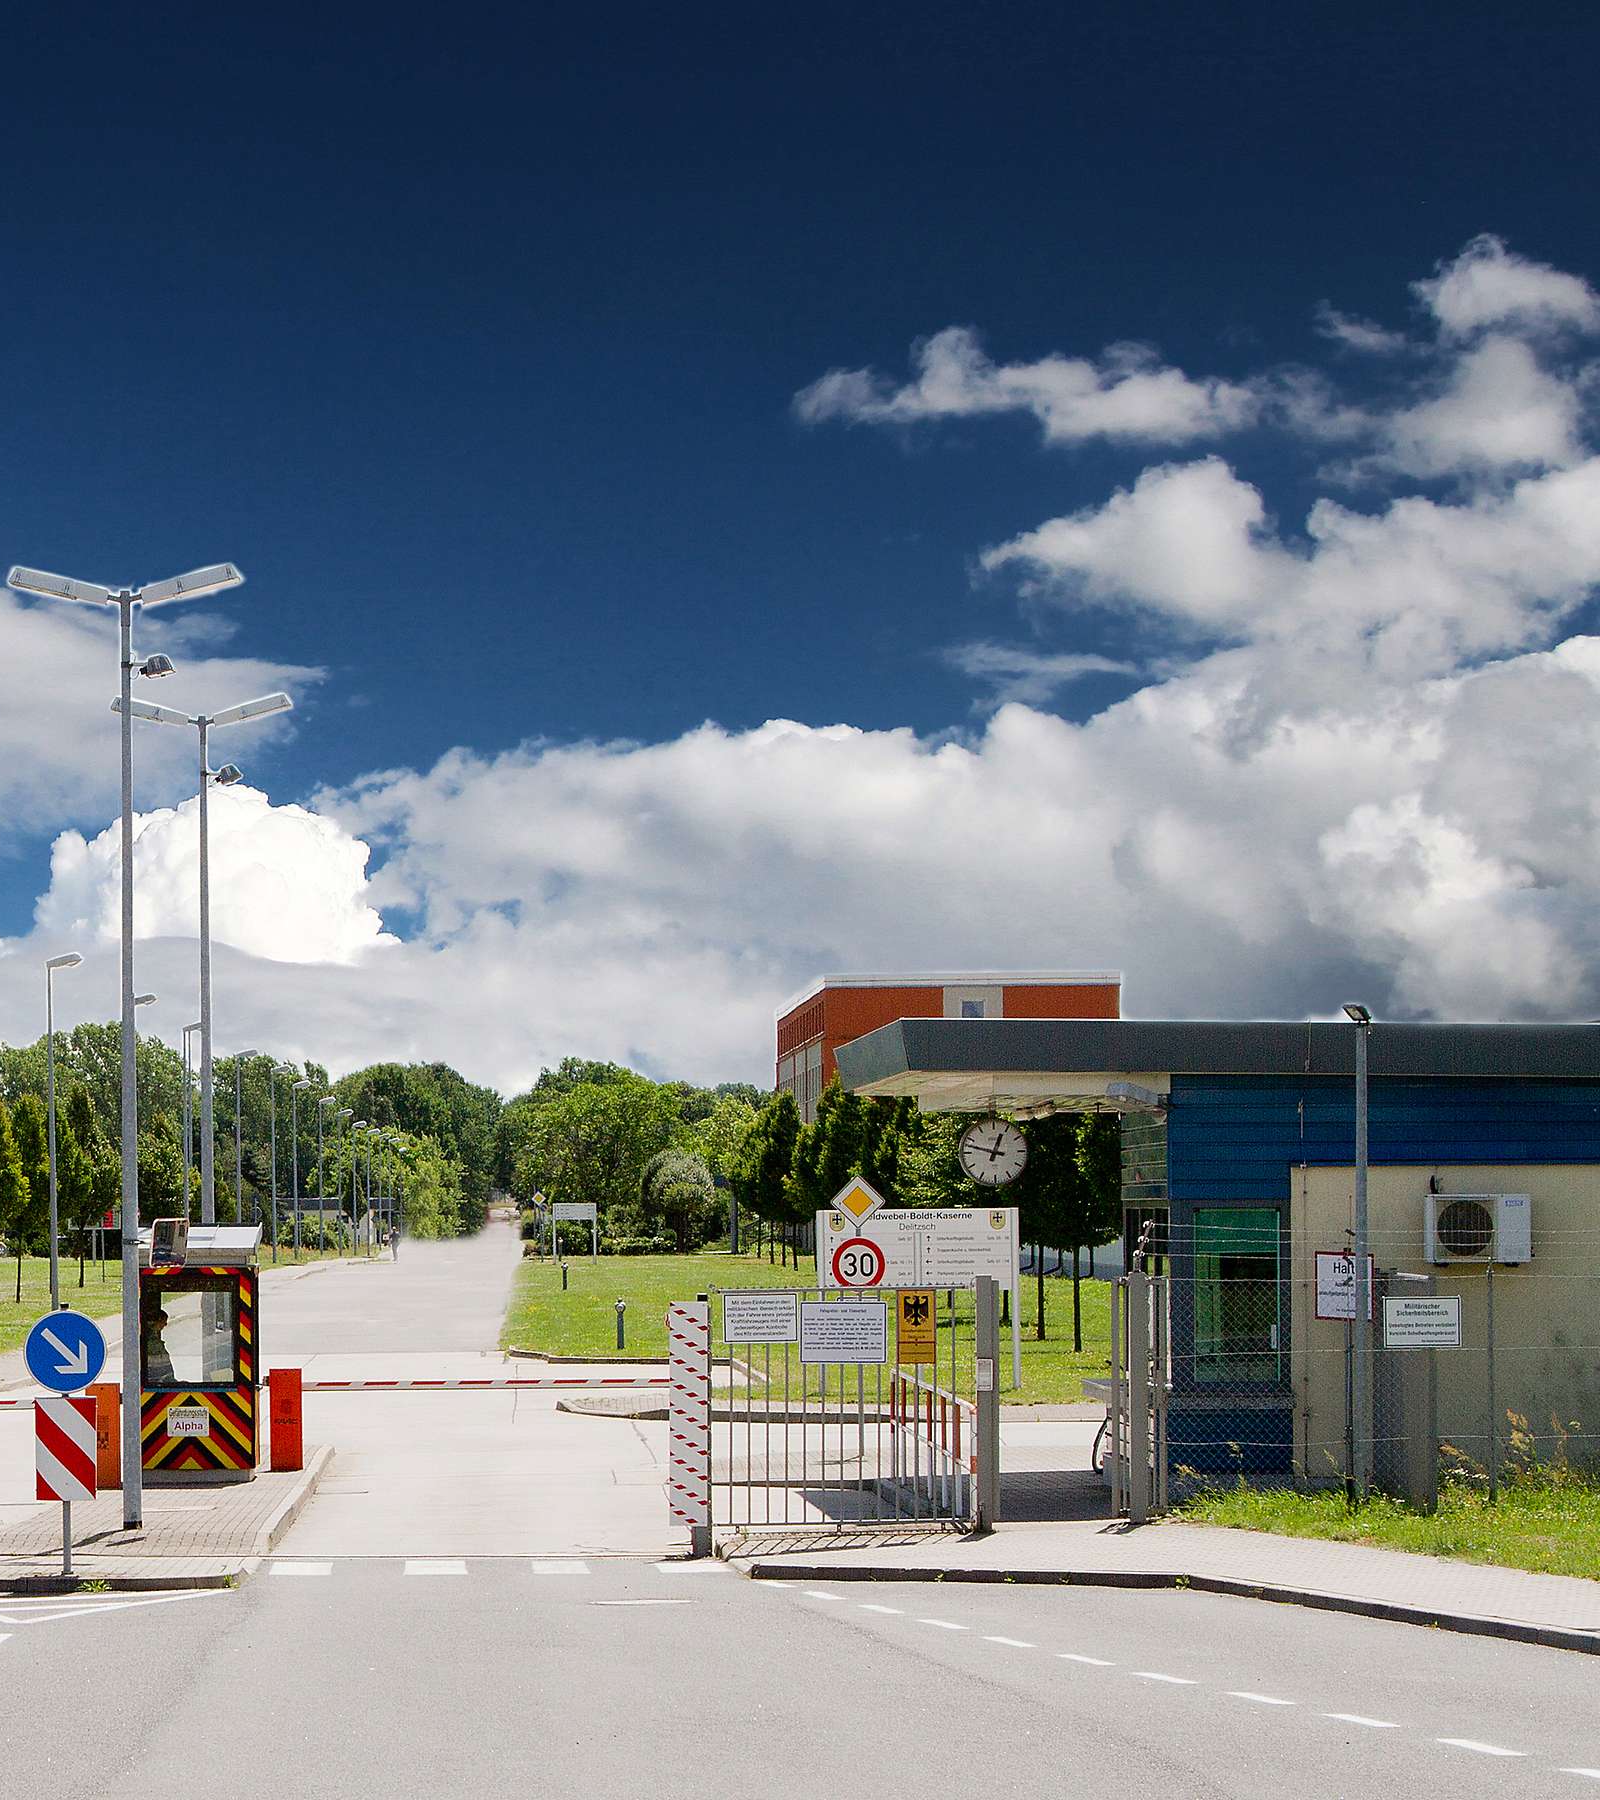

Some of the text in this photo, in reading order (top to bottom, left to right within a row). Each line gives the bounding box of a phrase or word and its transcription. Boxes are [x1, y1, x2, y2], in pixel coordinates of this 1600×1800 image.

[899, 1223, 936, 1231] Delitzsch
[843, 1252, 874, 1277] 30
[174, 1421, 204, 1432] Alpha
